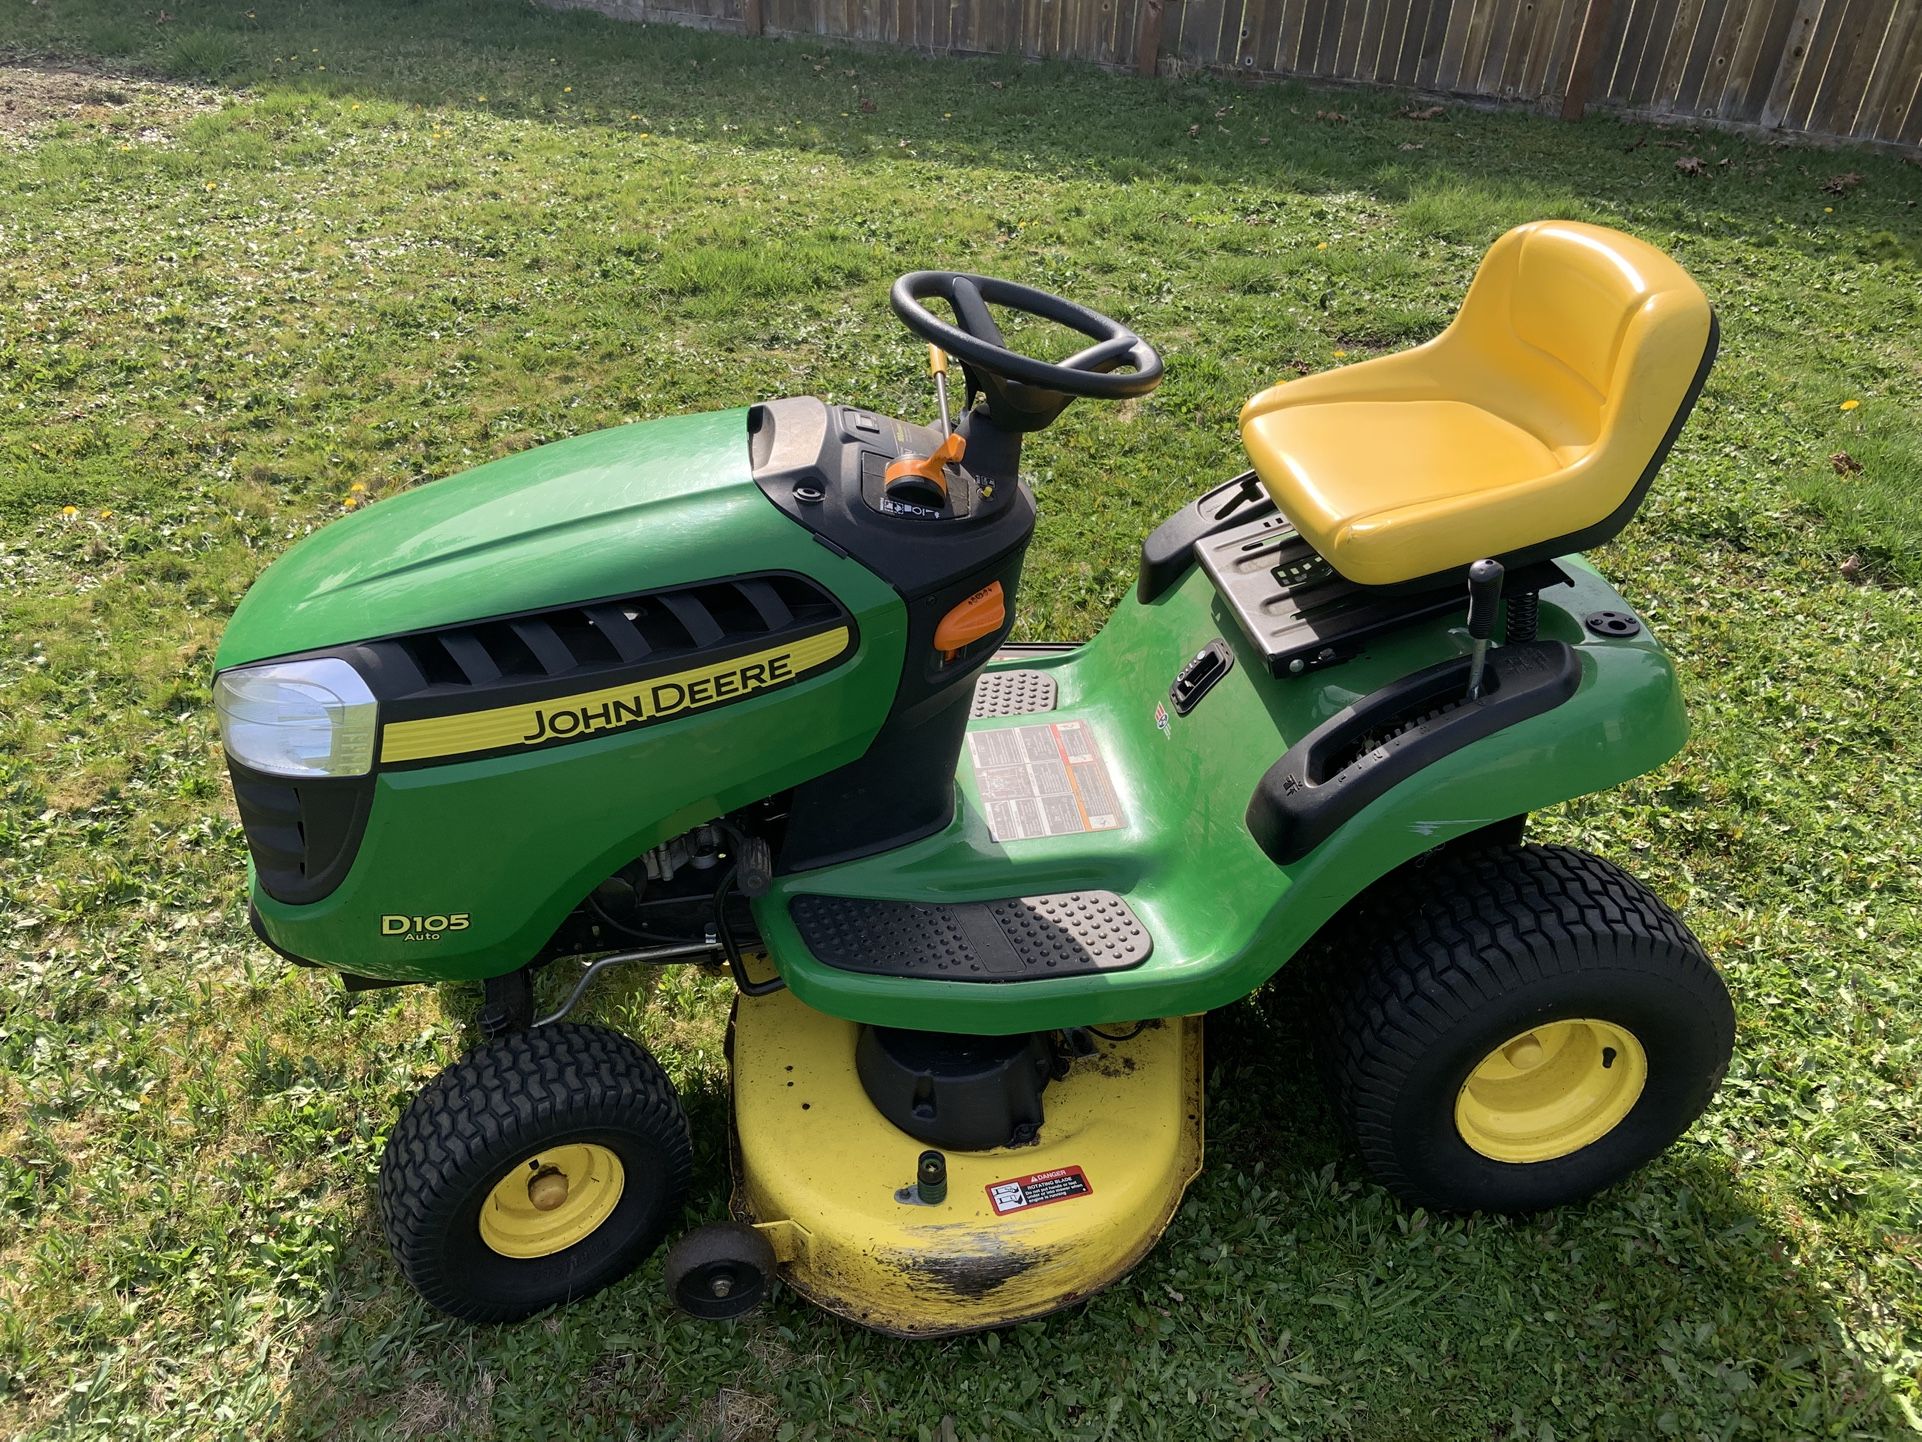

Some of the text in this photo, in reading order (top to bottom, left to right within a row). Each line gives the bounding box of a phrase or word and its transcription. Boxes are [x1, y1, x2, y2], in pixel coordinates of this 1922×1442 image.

[524, 654, 793, 741] JOHN DEERE
[382, 913, 470, 935] D105
[404, 933, 440, 941] Auto
[1037, 1170, 1066, 1180] DANGER
[1027, 1180, 1054, 1190] ROTATING
